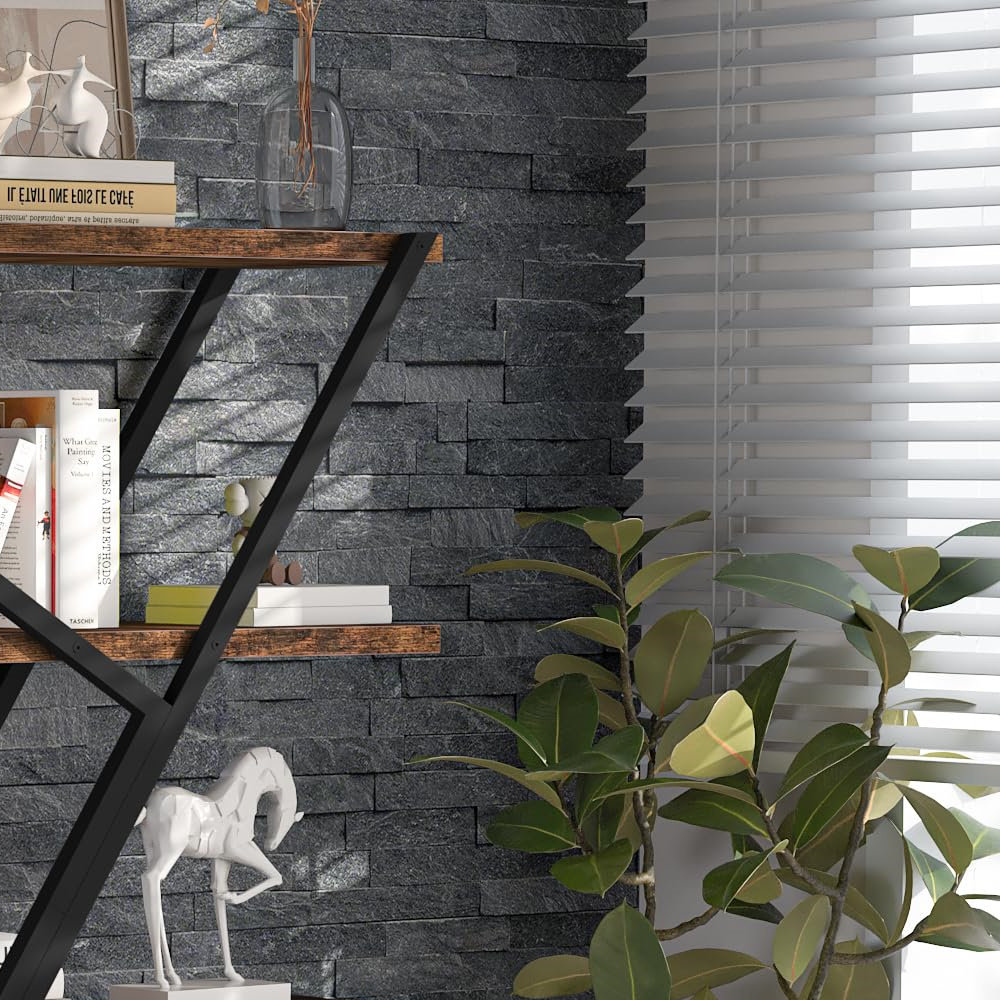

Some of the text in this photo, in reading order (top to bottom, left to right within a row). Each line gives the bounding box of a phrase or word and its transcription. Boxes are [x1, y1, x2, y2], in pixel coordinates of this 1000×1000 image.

[67, 447, 95, 456] Painting
[102, 445, 111, 585] MOVIES AND METHODS
